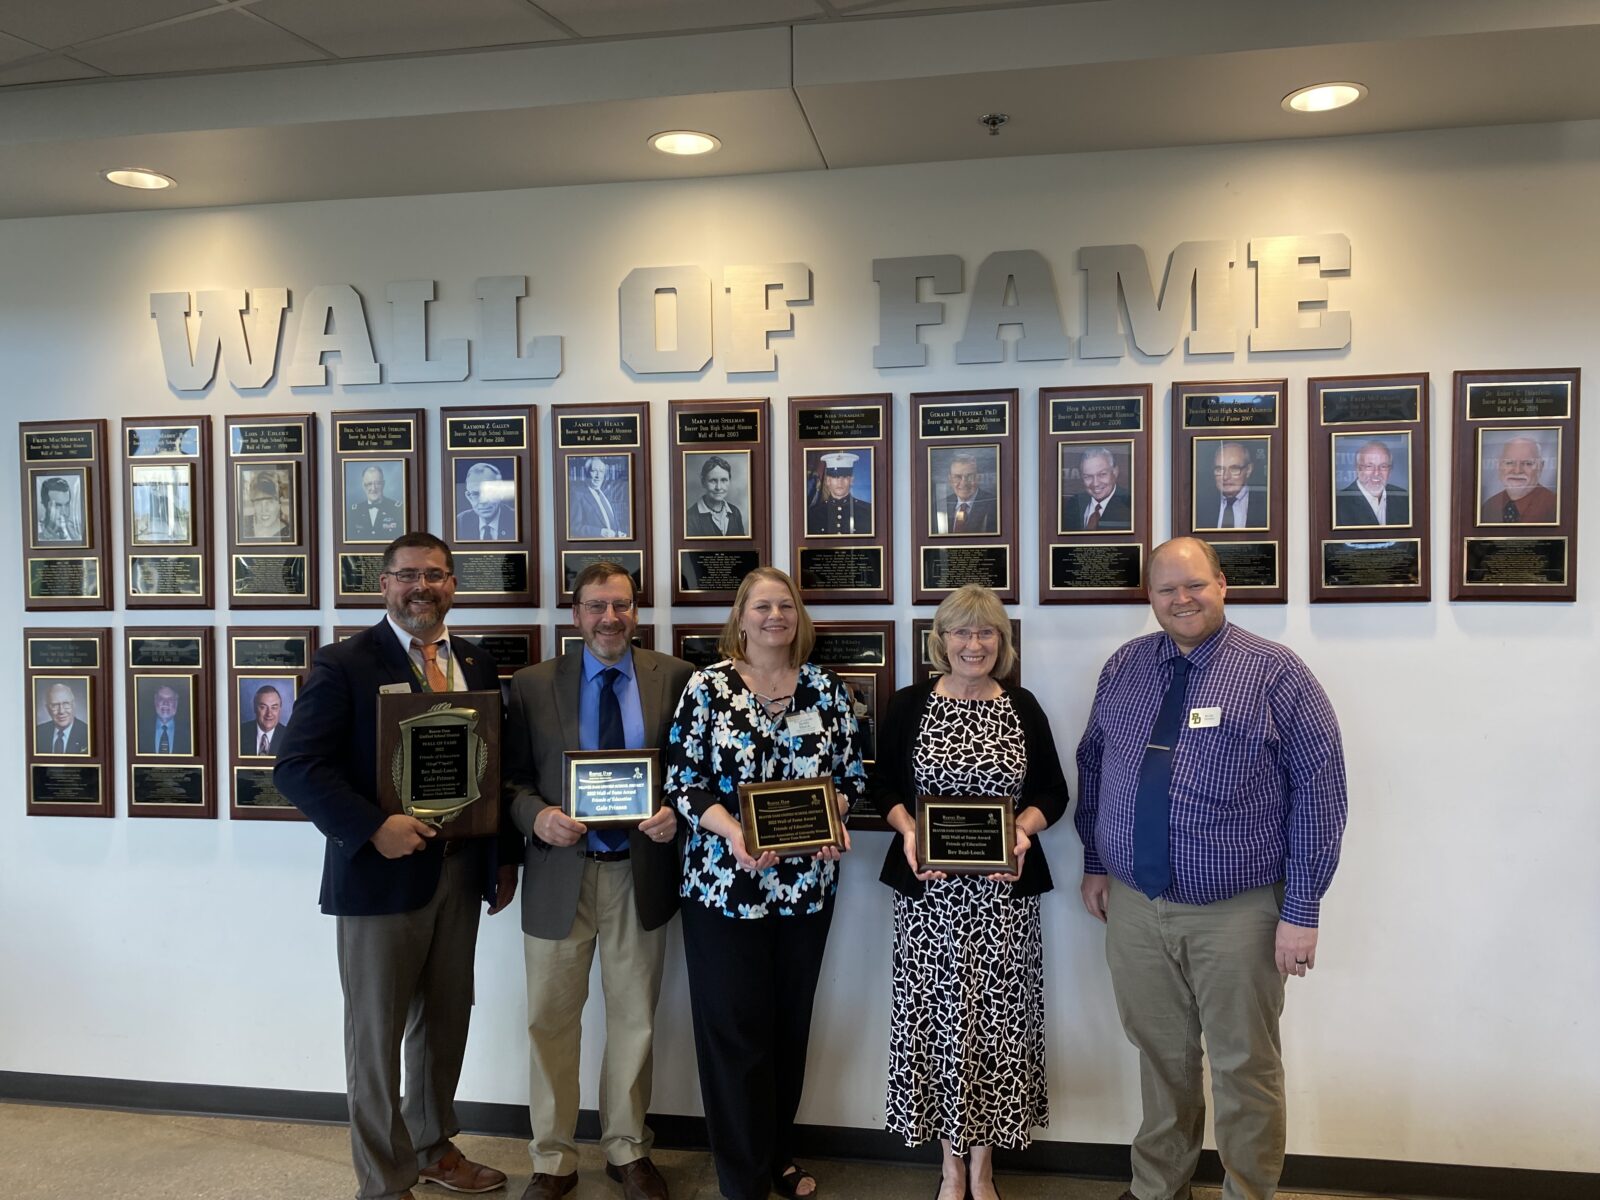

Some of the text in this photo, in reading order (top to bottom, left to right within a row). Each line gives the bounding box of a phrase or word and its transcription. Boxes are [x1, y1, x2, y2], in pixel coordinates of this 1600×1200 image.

[150, 233, 1350, 391] WALL OF FAME
